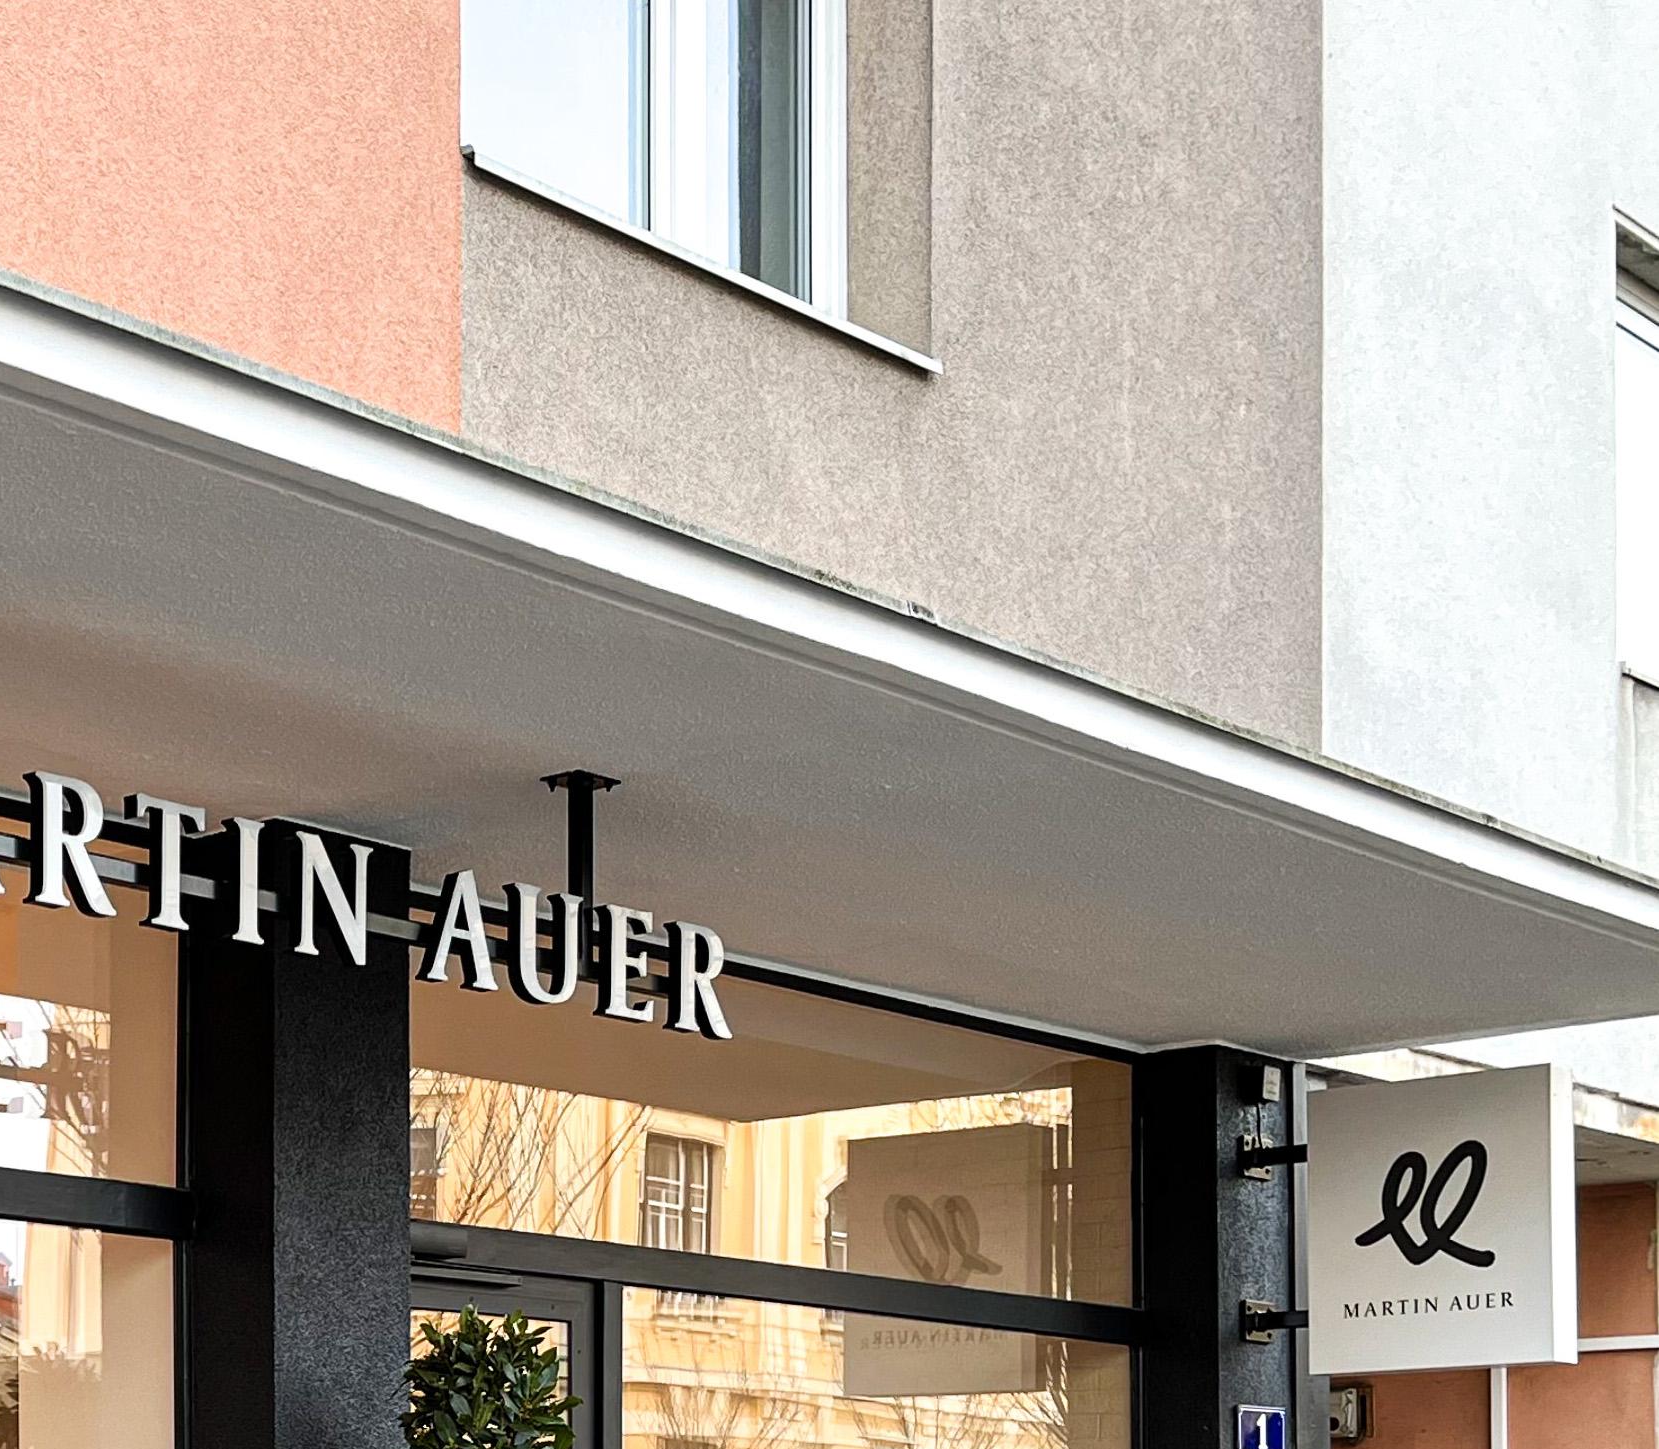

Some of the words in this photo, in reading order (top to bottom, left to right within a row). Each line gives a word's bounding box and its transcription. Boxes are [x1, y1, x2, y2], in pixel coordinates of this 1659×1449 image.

[415, 867, 733, 1041] AUER
[1343, 1296, 1439, 1319] MARTIN
[1449, 1291, 1515, 1311] AUER
